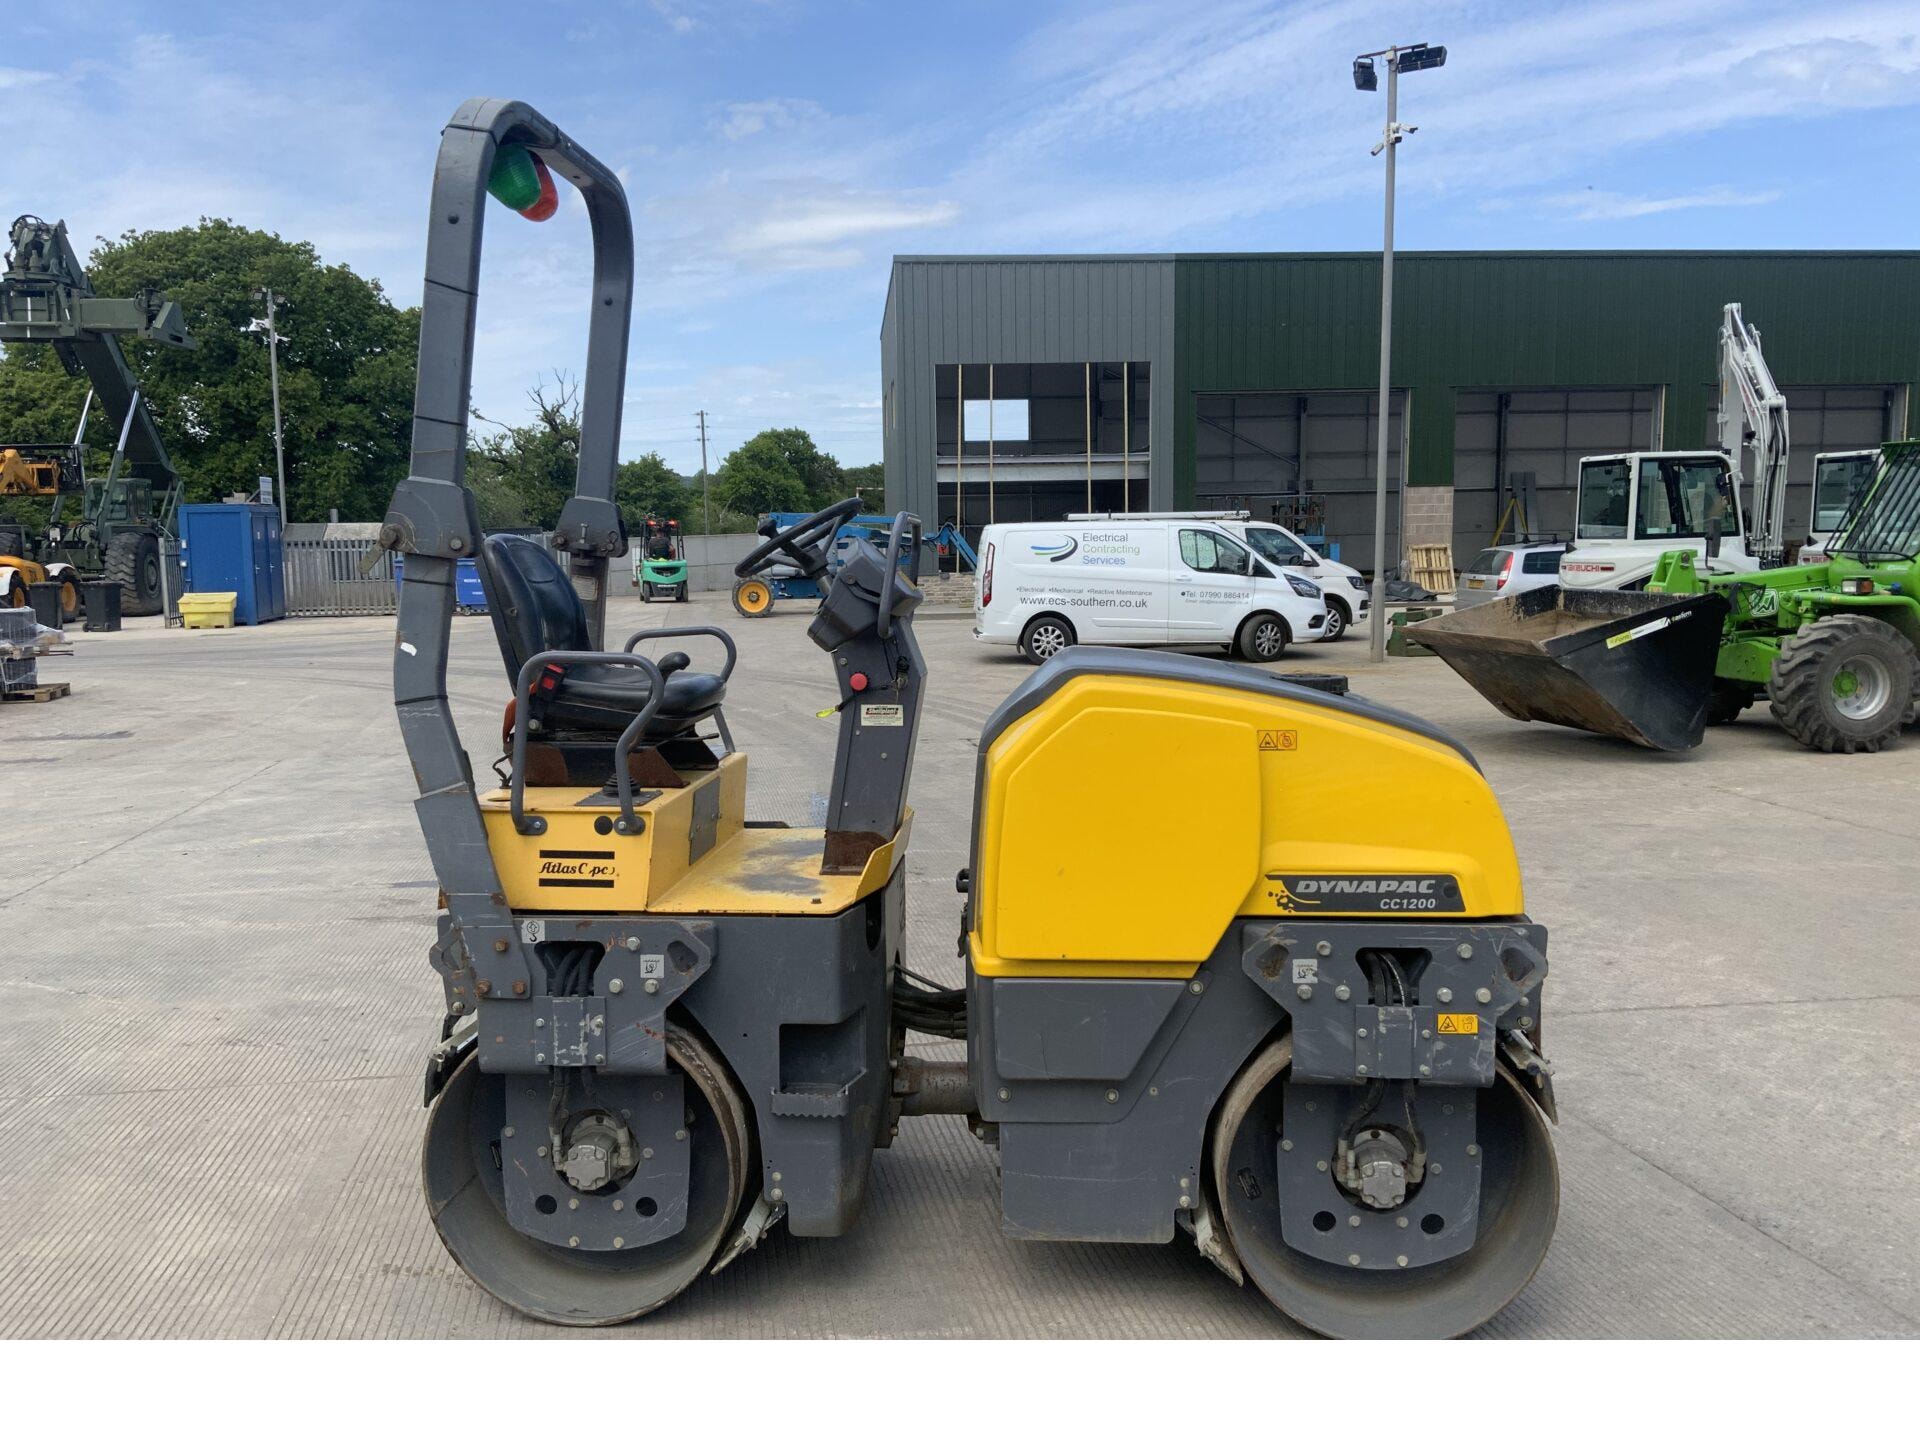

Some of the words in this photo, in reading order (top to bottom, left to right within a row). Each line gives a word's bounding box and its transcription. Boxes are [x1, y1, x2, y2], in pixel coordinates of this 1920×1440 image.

[1082, 532, 1129, 542] Electrical
[1082, 544, 1141, 556] Contracting
[1082, 555, 1126, 565] Services
[1020, 597, 1148, 608] www.ecs-southern.co.uk
[539, 862, 577, 874] Atlas
[578, 862, 615, 877] Cpc
[1296, 880, 1436, 894] DYNAPAC
[1380, 898, 1436, 909] CC1200
